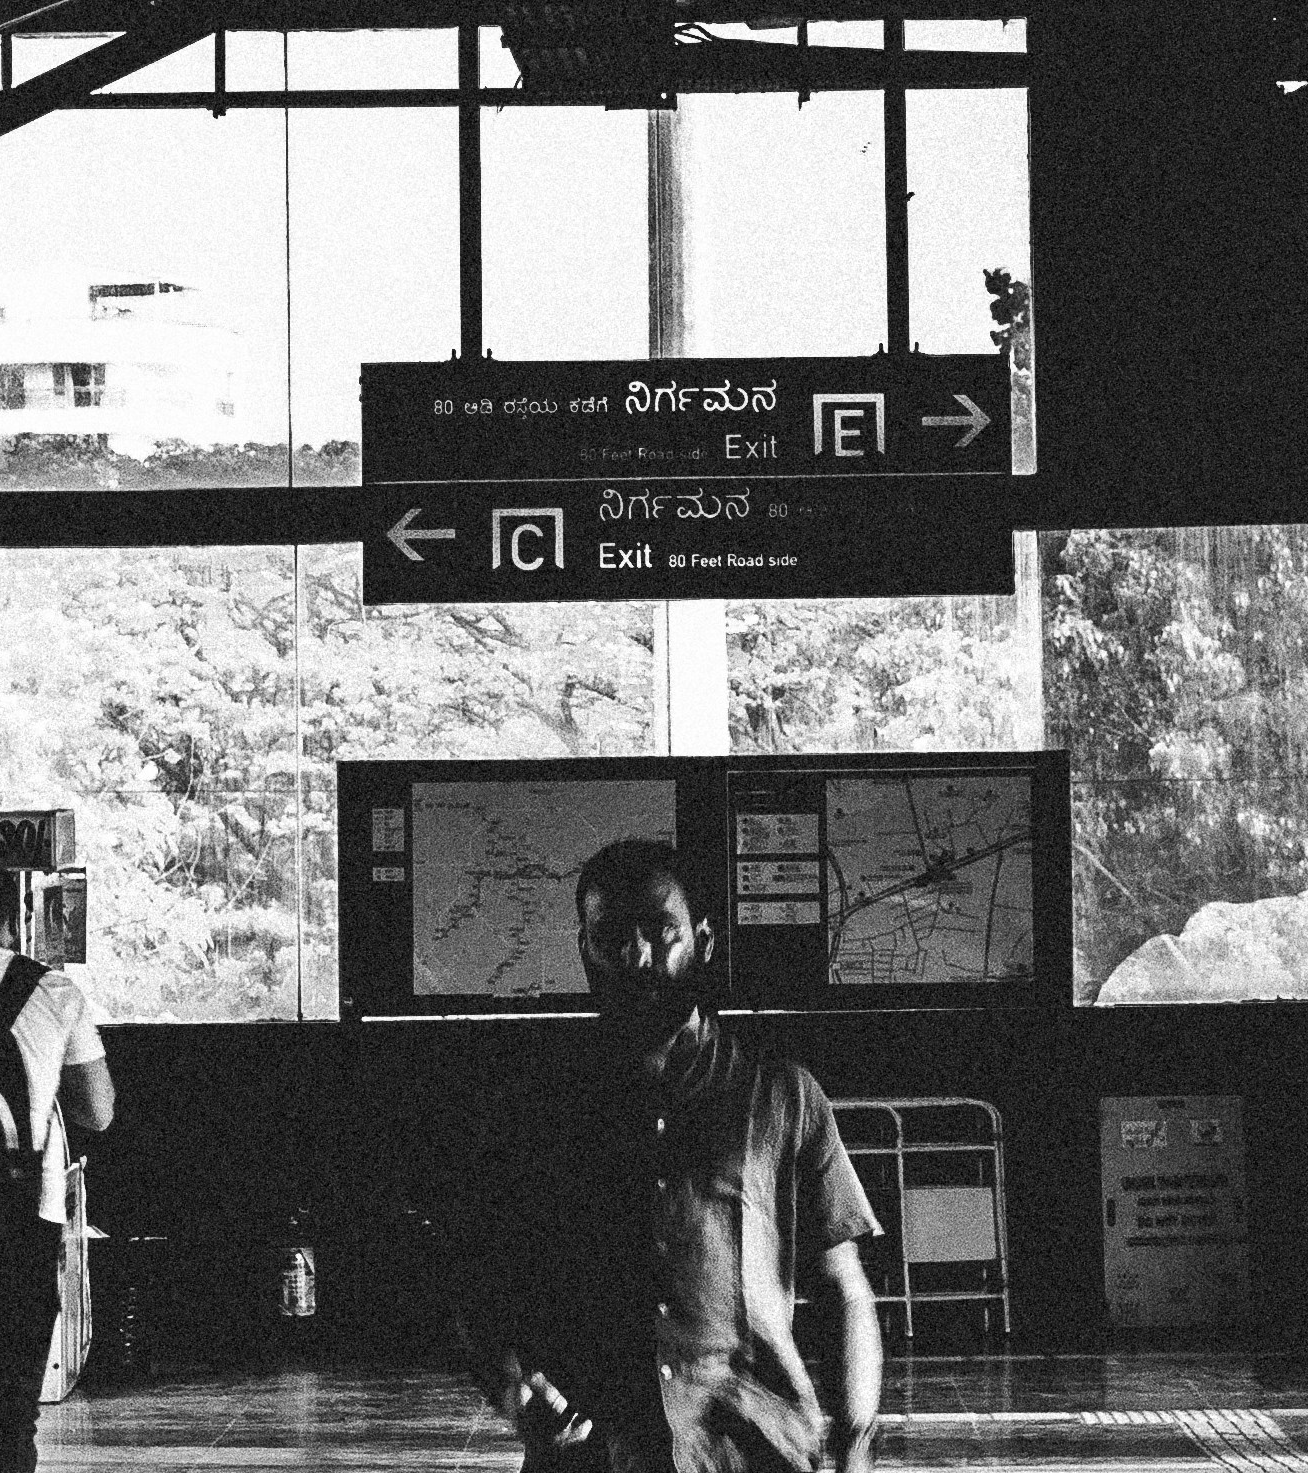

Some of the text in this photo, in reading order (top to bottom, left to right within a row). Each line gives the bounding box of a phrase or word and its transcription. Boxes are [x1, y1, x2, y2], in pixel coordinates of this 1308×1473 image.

[434, 399, 453, 415] 80
[625, 379, 777, 414] ನಿರ್ಗಮನ
[725, 433, 777, 459] Exit
[834, 409, 864, 457] E
[599, 487, 750, 521] ನಿರ್ಗಮನ
[768, 503, 788, 518] 80
[511, 523, 545, 571] C
[599, 542, 798, 569] Exit 80 Feet Road side
